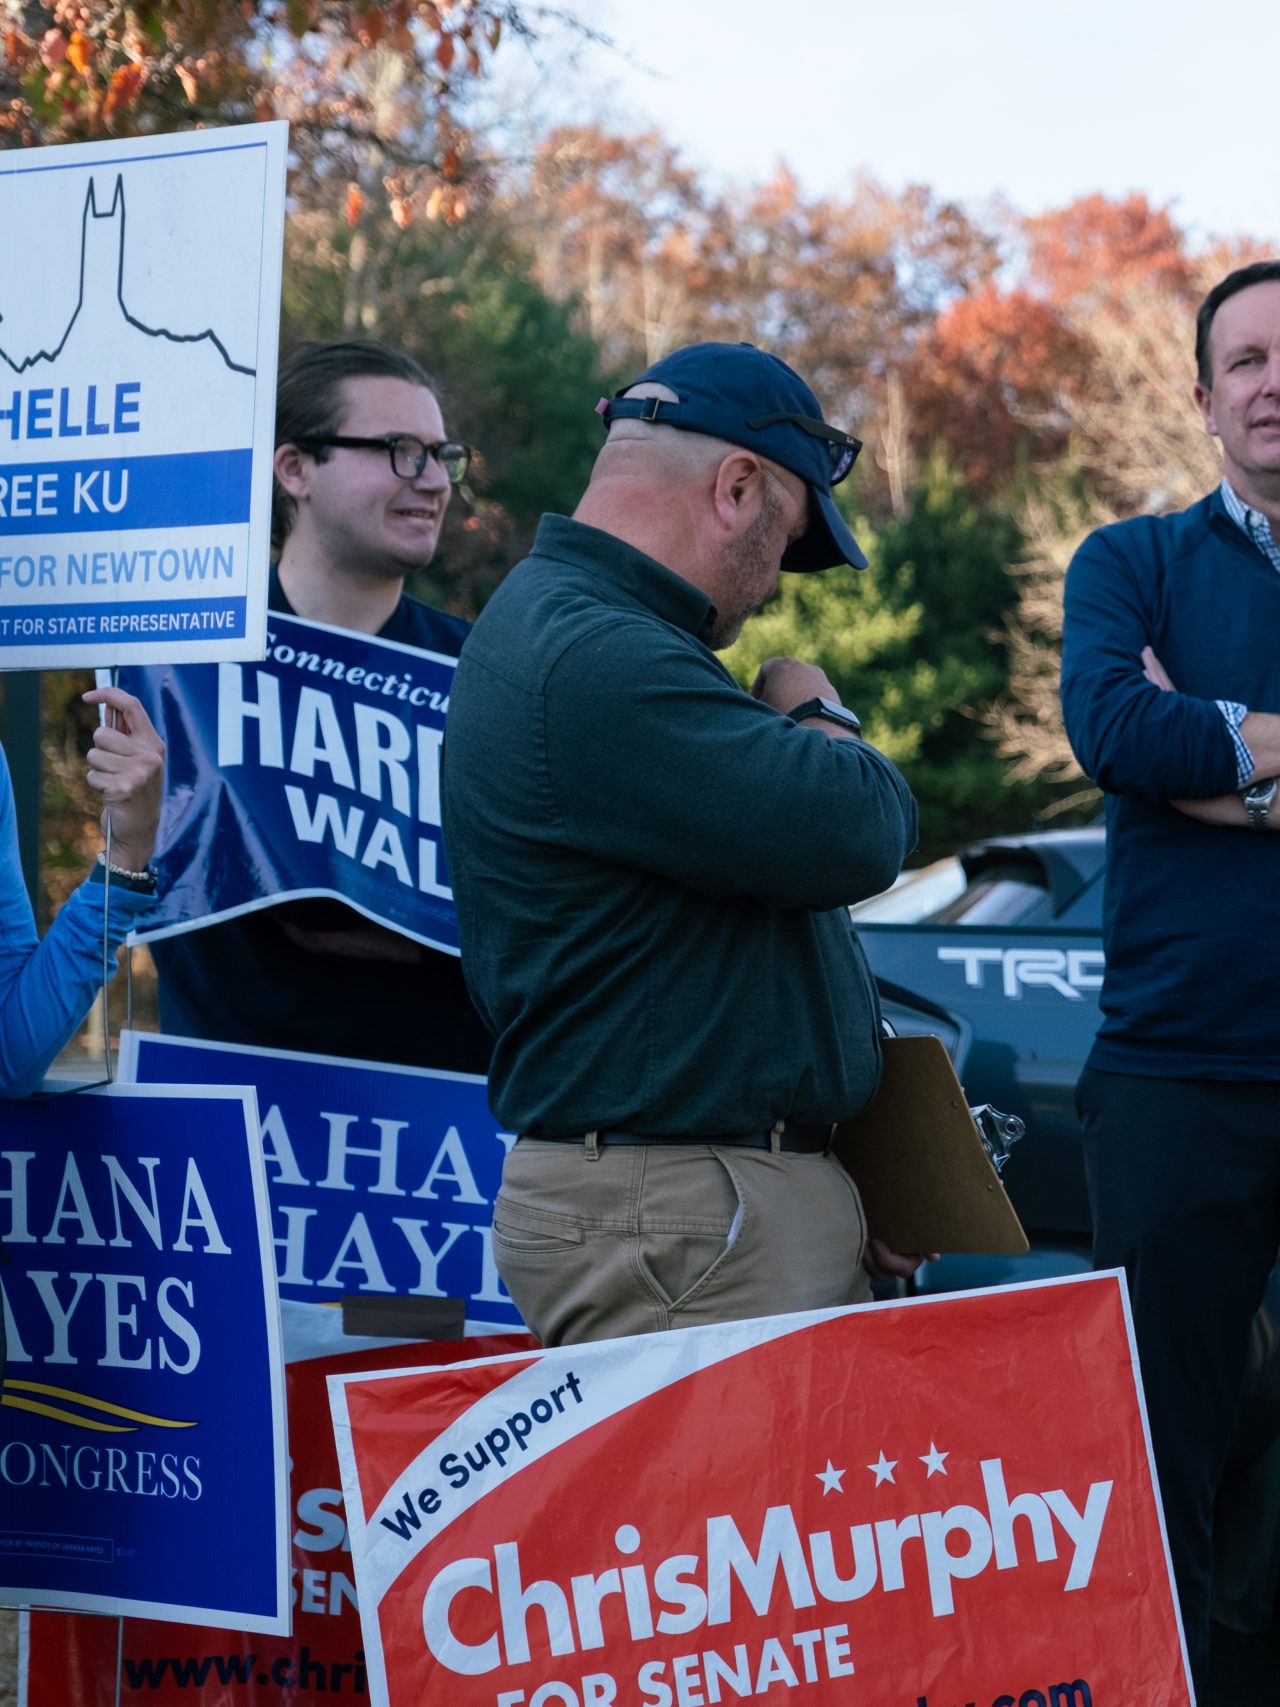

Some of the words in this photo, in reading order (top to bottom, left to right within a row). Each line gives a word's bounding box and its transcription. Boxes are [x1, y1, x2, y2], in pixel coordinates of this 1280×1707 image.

[73, 469, 129, 514] KU
[0, 555, 57, 587] FOR
[67, 546, 235, 586] NEWTOWN
[13, 619, 44, 635] FOR
[48, 616, 96, 634] STATE
[101, 611, 235, 633] REPRESENTATIVE
[262, 1104, 517, 1205] AHA
[0, 1442, 202, 1500] ONGRESS
[380, 1488, 442, 1542] We
[439, 1371, 583, 1489] Support
[422, 1458, 1114, 1676] ChrisMurphy
[497, 1672, 618, 1707] OR
[637, 1623, 855, 1707] SENATE
